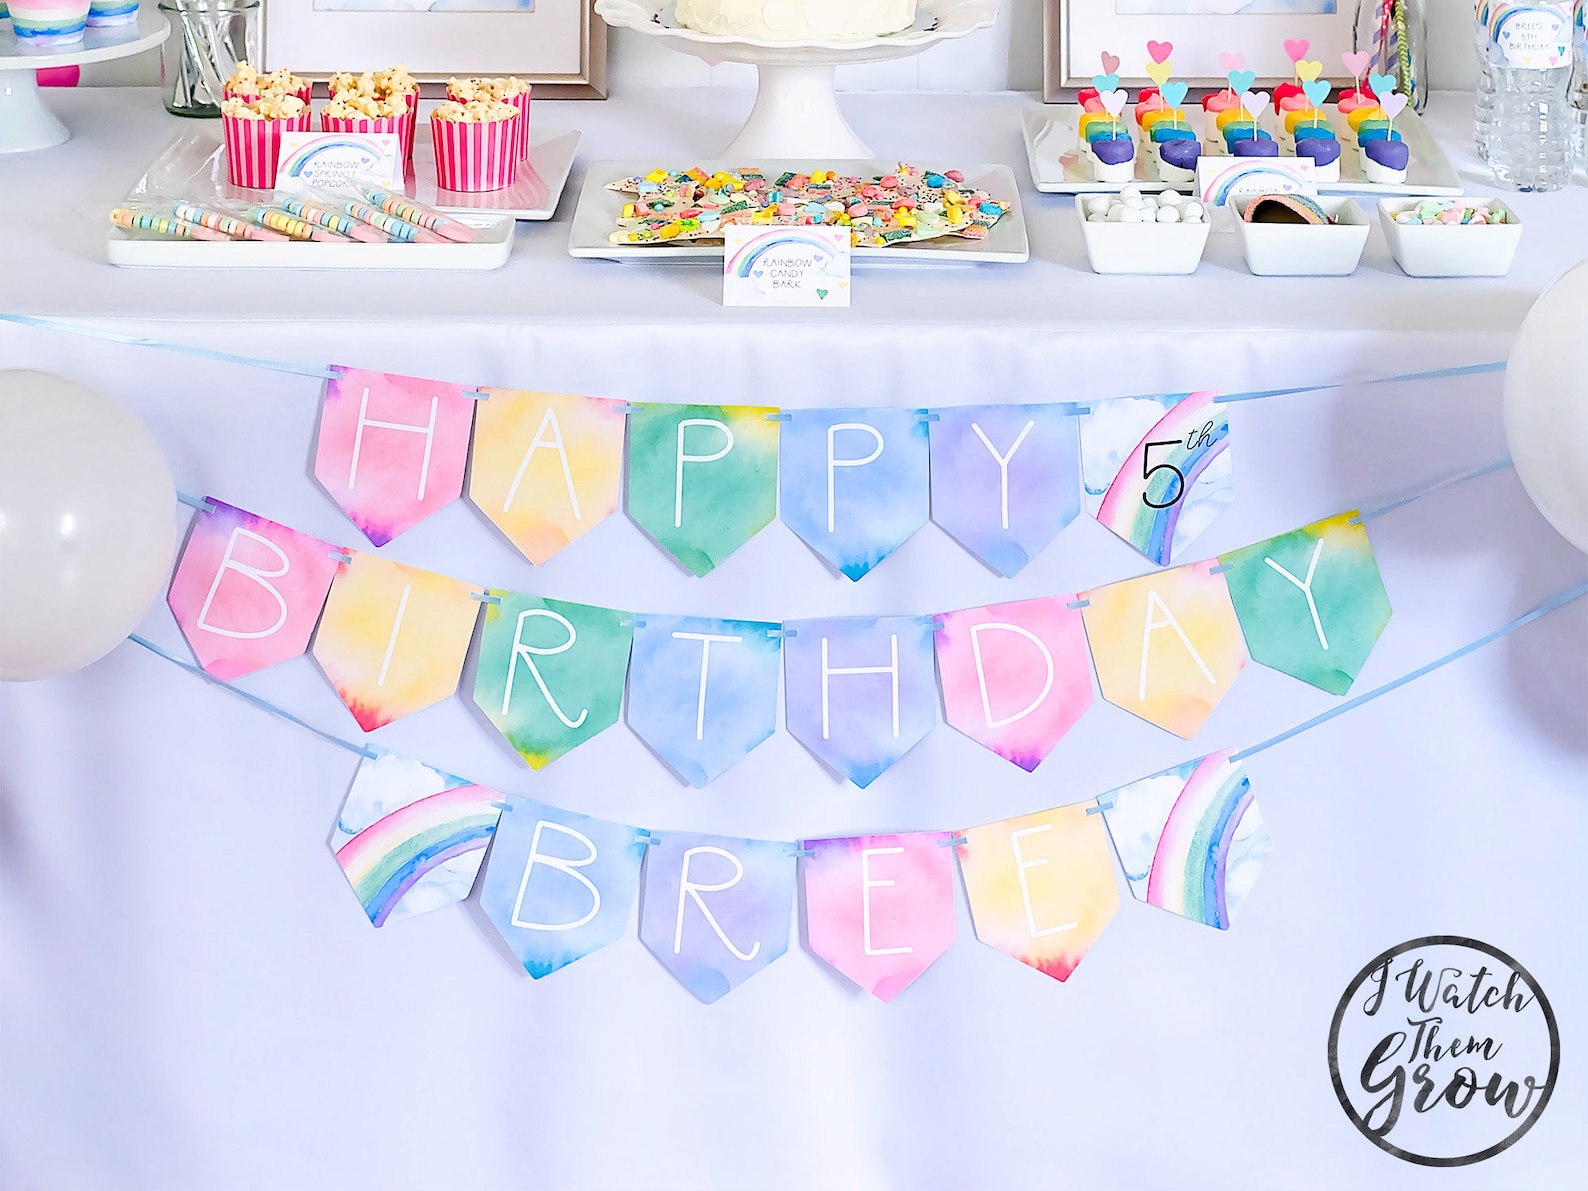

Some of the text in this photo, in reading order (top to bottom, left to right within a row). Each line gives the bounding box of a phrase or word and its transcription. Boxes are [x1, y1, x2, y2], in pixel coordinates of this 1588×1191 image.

[313, 161, 360, 169] RAINBOW
[763, 258, 813, 268] RAINBOW
[770, 269, 805, 278] CANDY
[772, 280, 801, 289] BARK
[347, 386, 1218, 533] HAPPY 5th
[196, 525, 1330, 742] BIRTHDAY
[511, 819, 1079, 962] BREE
